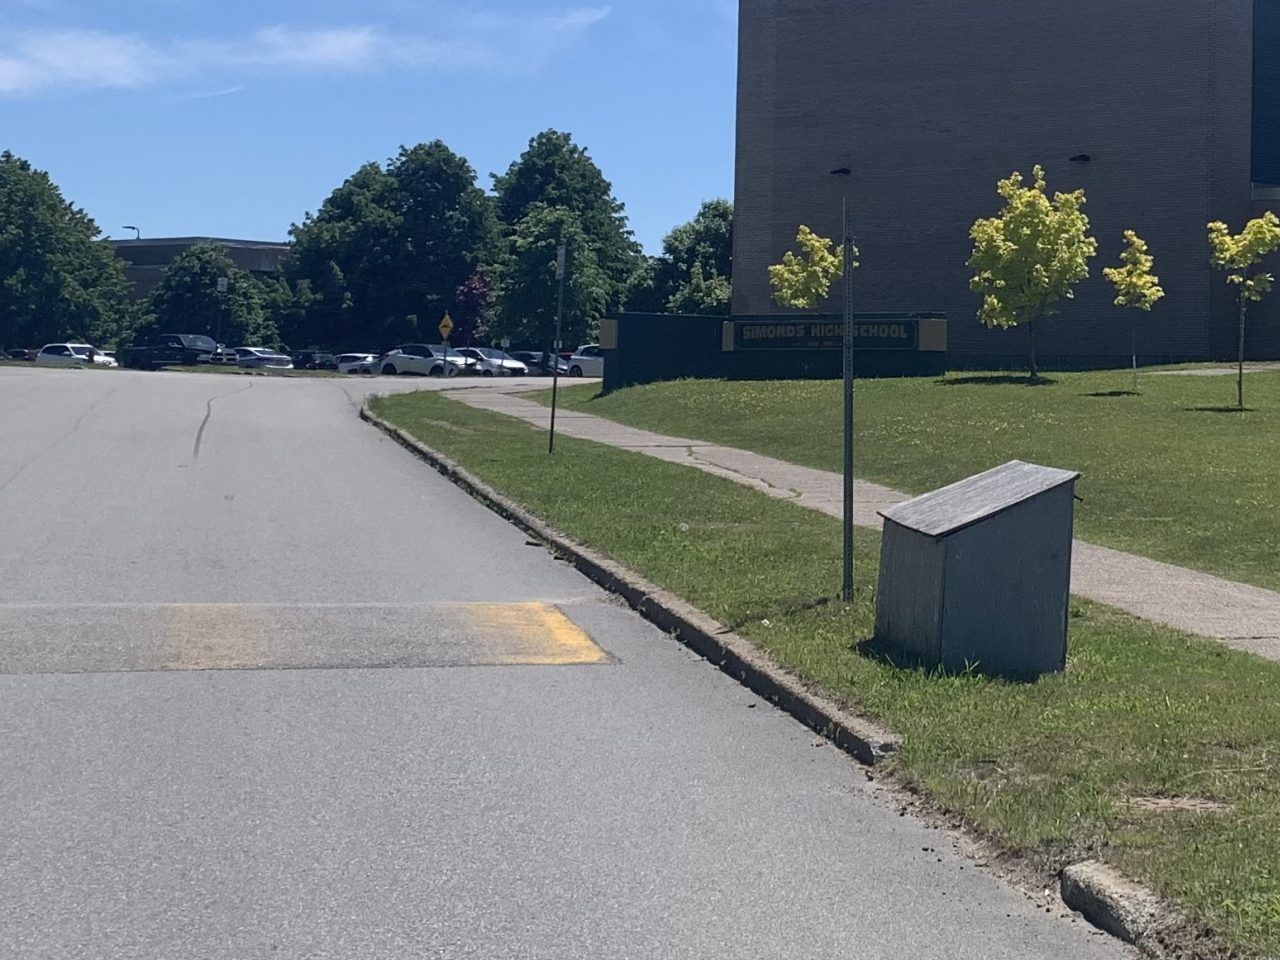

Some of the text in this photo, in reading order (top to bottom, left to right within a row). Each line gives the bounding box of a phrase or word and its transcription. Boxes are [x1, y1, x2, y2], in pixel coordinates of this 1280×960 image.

[743, 324, 907, 339] SIMONDS HIGH SCHOOL
